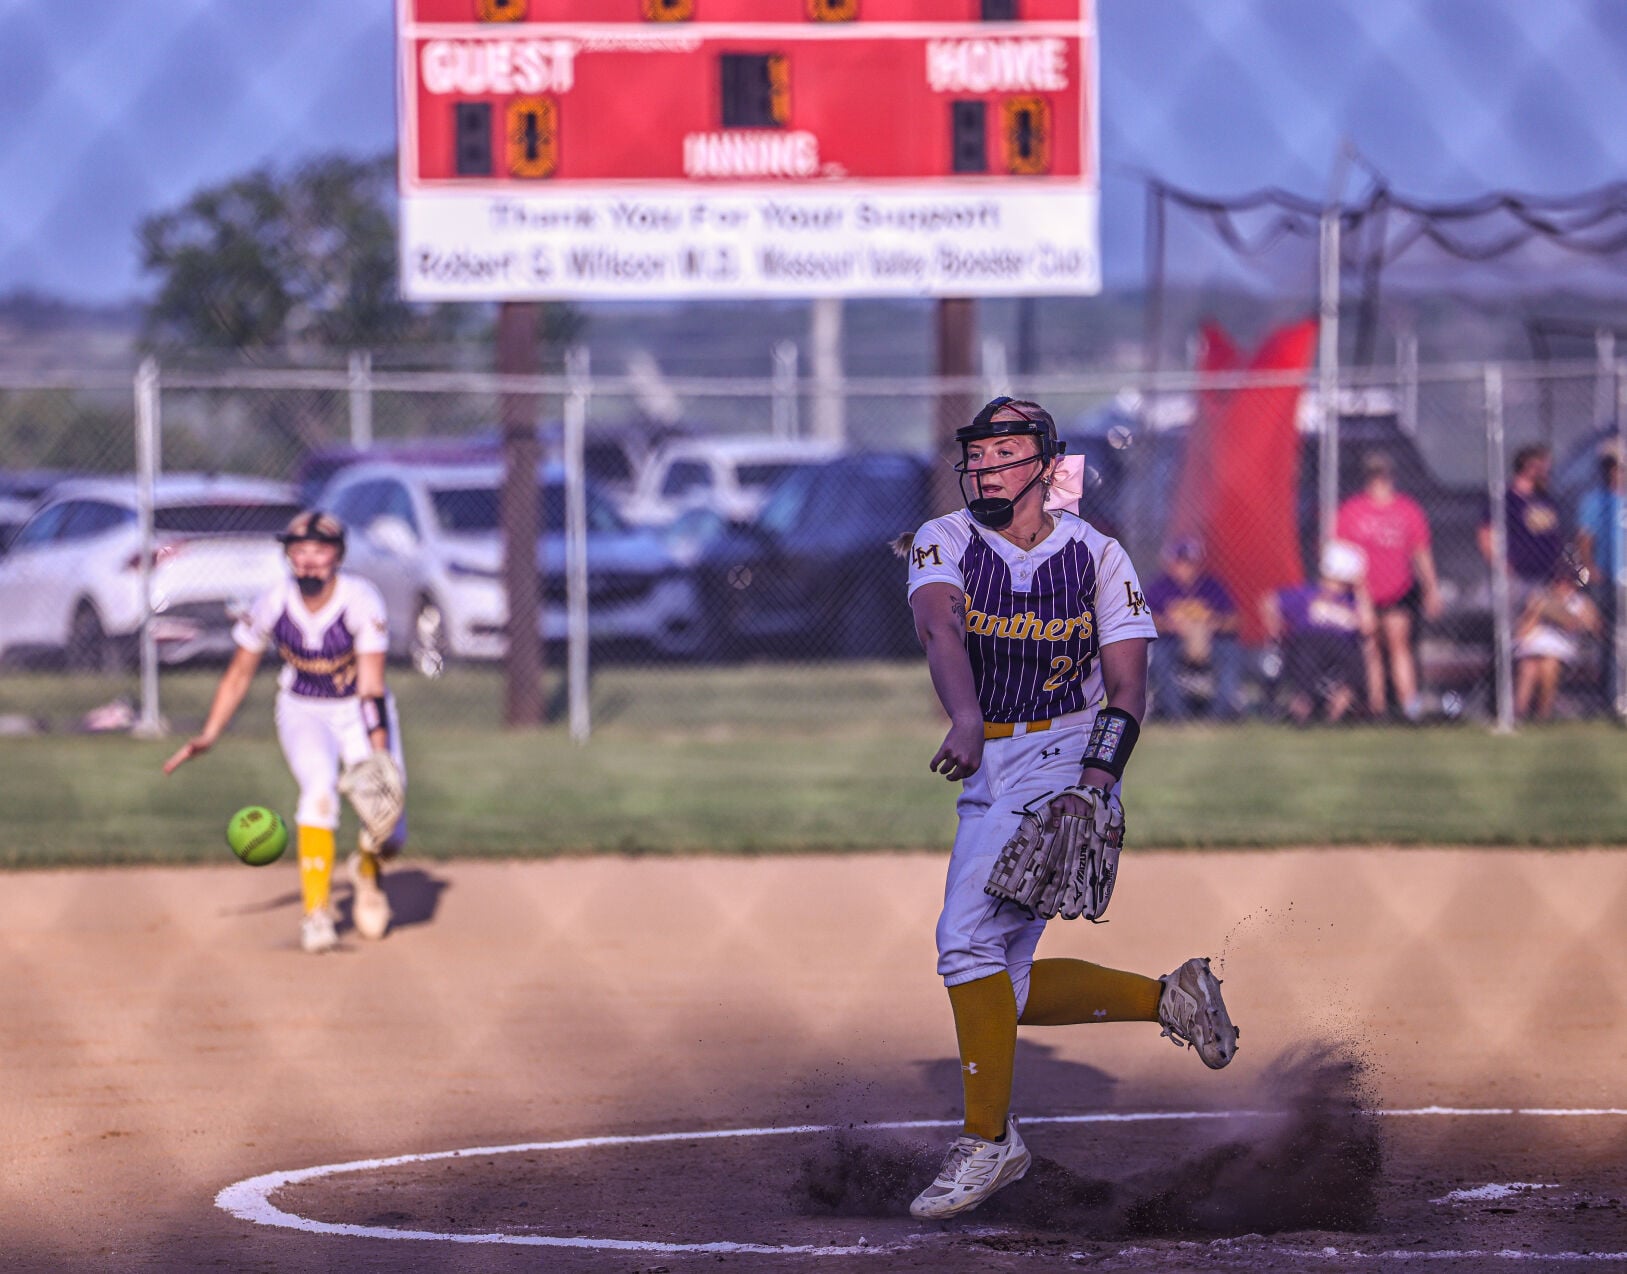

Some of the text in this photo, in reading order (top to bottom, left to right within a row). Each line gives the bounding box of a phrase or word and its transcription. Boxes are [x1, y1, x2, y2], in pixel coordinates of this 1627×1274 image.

[421, 39, 575, 94] GUEST
[926, 38, 1069, 93] HOME
[505, 95, 559, 179] 0
[682, 131, 819, 178] INNING
[1003, 94, 1051, 175] 0
[488, 203, 595, 230] Thank
[611, 202, 682, 230] You
[689, 202, 749, 229] For
[760, 202, 843, 230] Your
